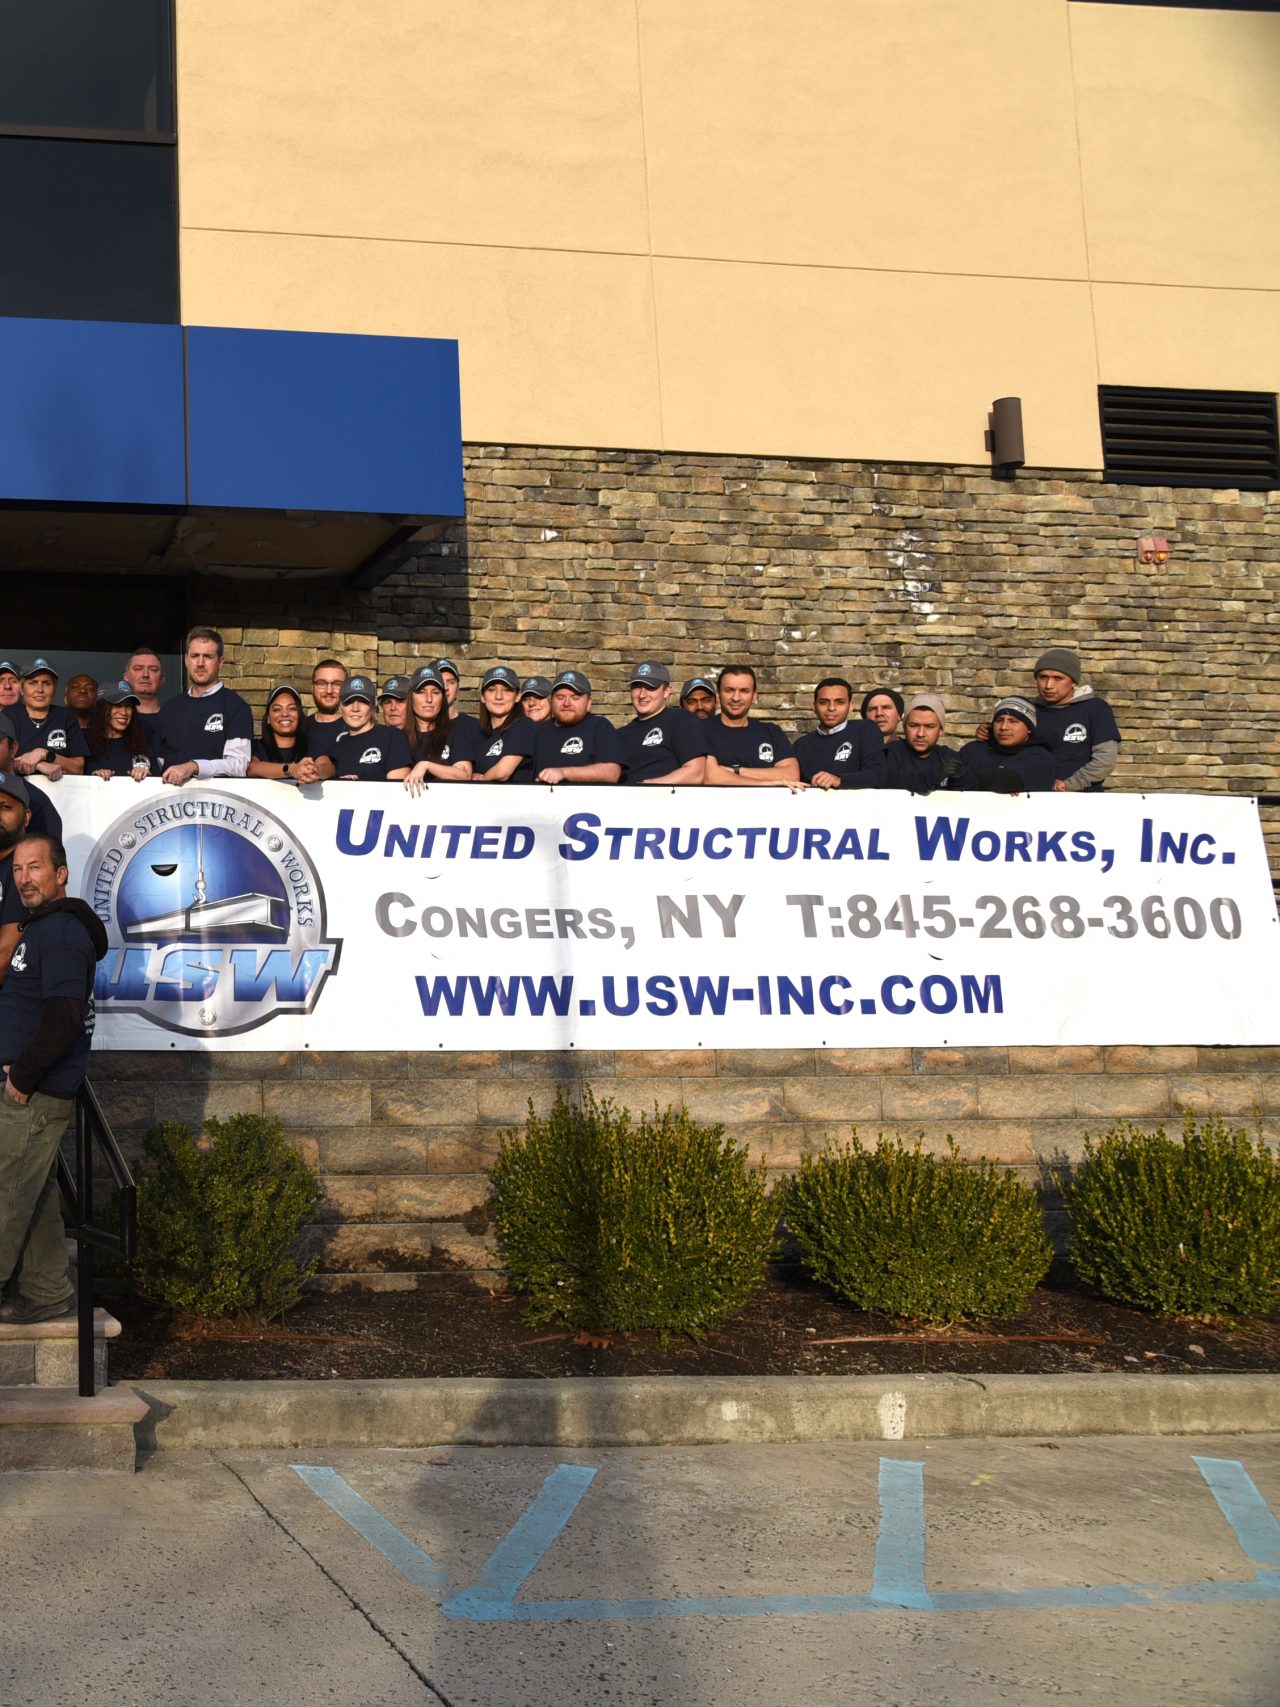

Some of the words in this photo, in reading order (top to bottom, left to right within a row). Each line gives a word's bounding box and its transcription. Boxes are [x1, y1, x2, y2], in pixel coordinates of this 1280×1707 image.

[94, 848, 124, 925] UNITED
[133, 801, 266, 838] STRUCTURAL
[279, 850, 315, 928] WORKS
[335, 808, 536, 860] UNITED
[559, 812, 890, 862] STRUCTURAL
[914, 815, 1116, 874] WORKS,
[1140, 818, 1236, 865] INC.
[375, 891, 636, 950] CONGERS,
[656, 894, 746, 939] NY
[786, 893, 1243, 940] T:845-268-3600
[415, 974, 1004, 1018] WWW.USW-INC.COM
